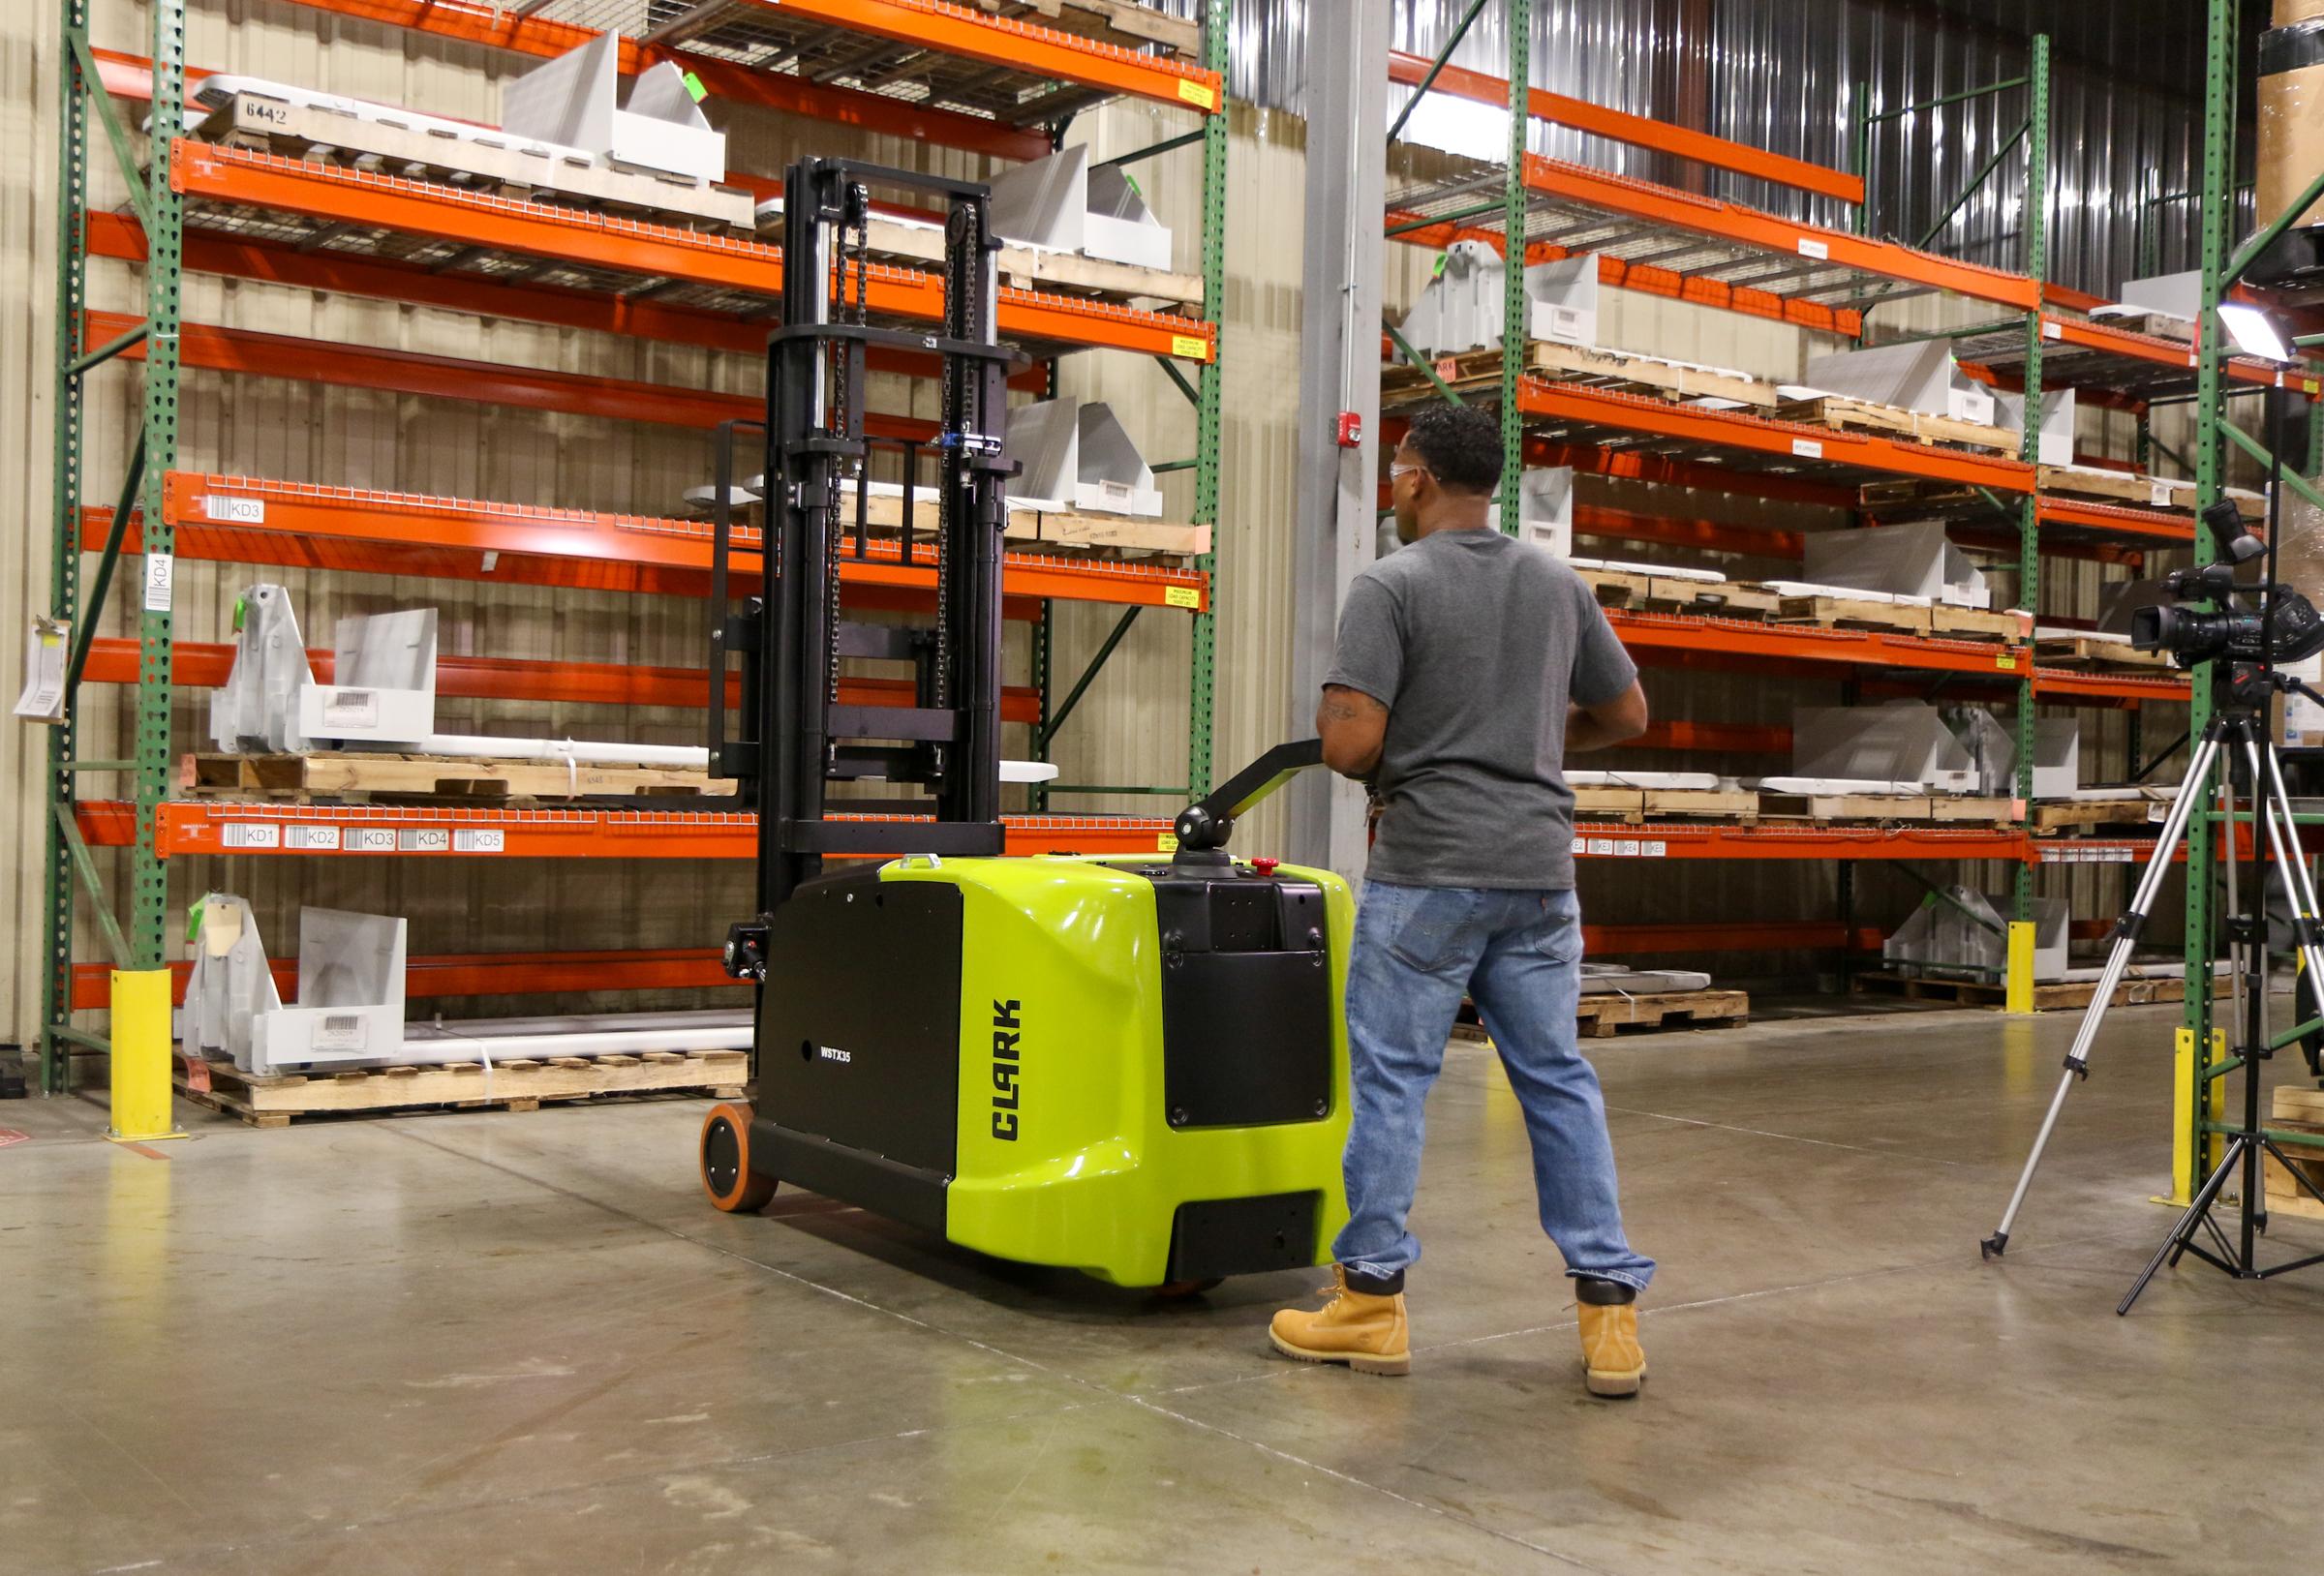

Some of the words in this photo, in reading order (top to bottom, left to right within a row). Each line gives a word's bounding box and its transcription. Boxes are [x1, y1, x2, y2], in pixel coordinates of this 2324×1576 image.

[231, 503, 260, 517] KD3
[154, 559, 167, 587] KD4
[247, 830, 274, 842] KD1
[308, 831, 335, 844] KD2
[364, 833, 394, 846] KD3
[418, 833, 447, 845] KD4
[475, 834, 501, 846] KD5
[820, 1046, 851, 1063] WSTX35
[992, 999, 1021, 1142] CLARK
